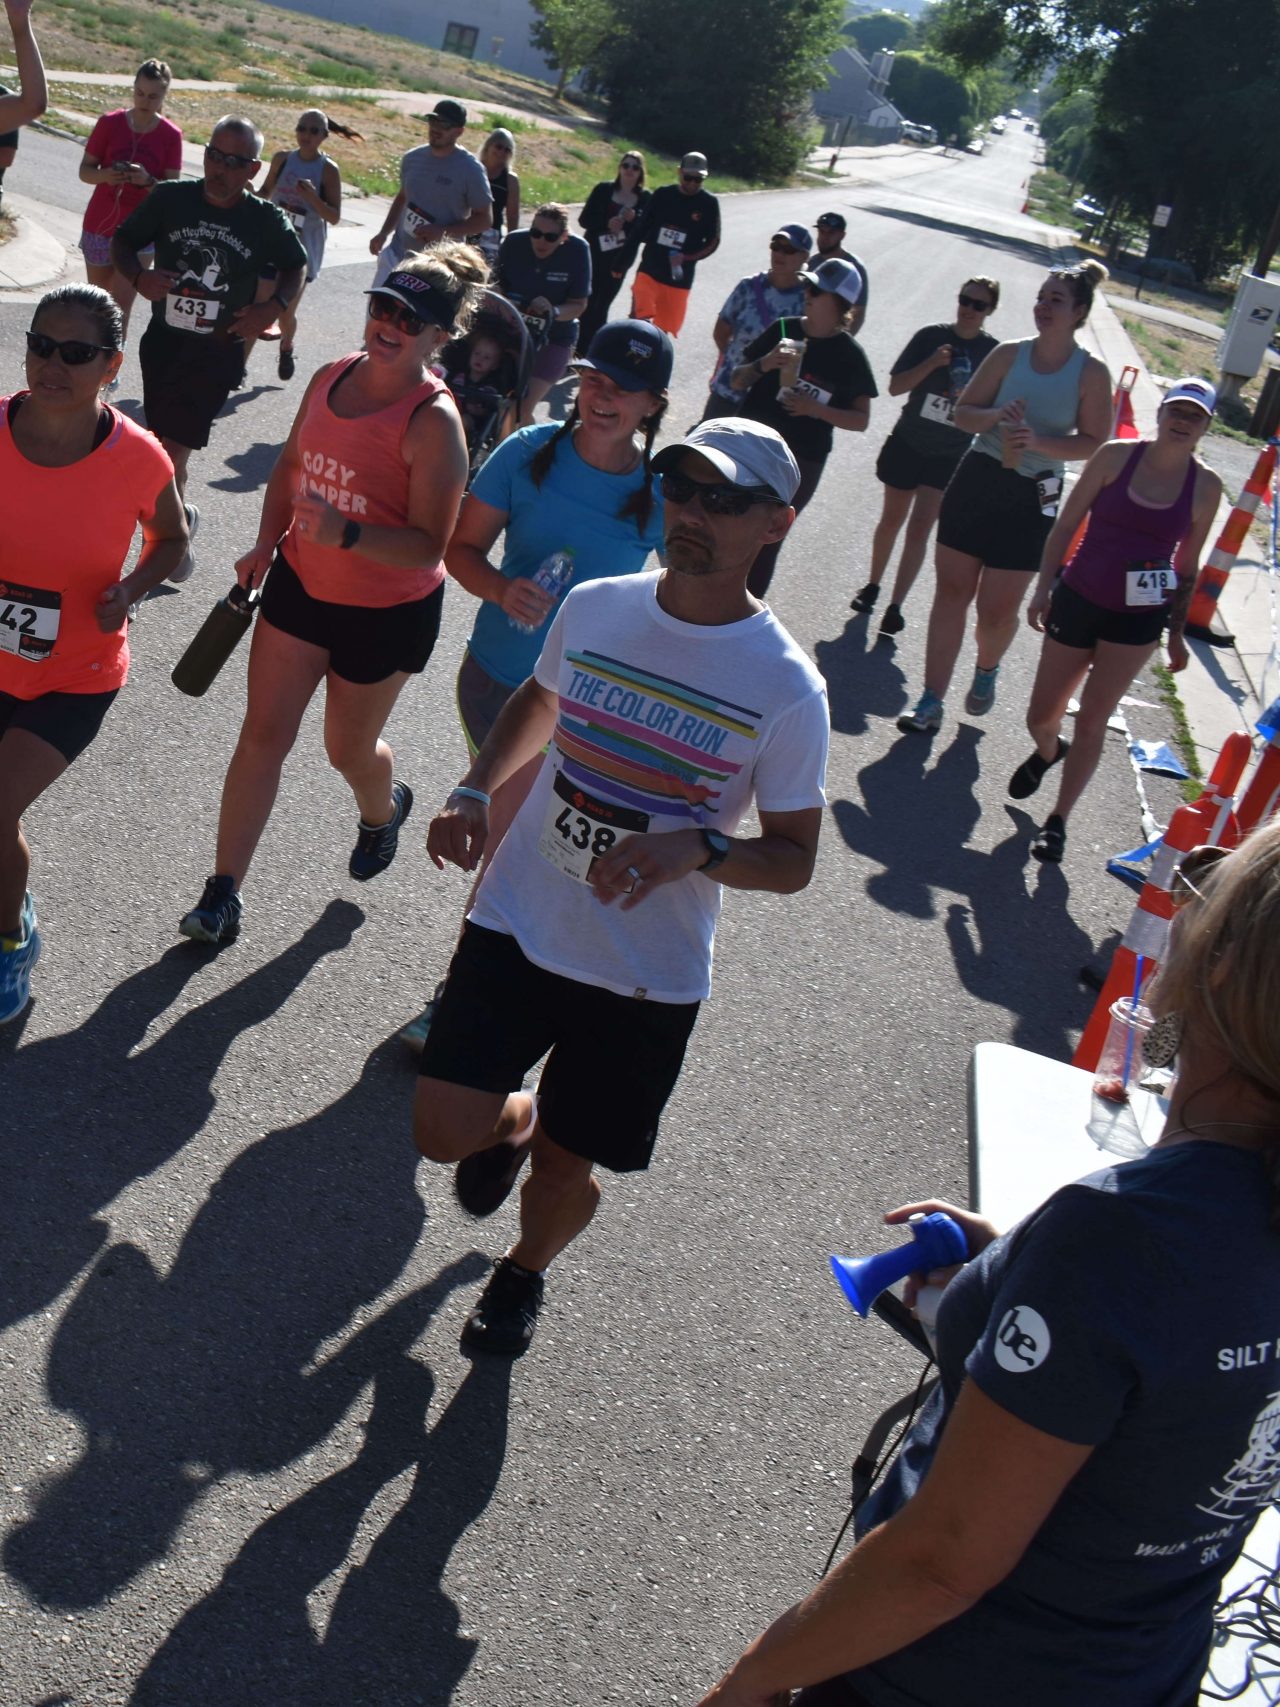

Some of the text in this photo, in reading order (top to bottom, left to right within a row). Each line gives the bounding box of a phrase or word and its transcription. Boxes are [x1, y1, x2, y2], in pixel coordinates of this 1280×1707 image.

[173, 298, 207, 318] 433
[303, 451, 356, 488] COZY
[299, 472, 368, 516] AMPER
[1136, 571, 1168, 589] 418
[567, 670, 607, 706] THE
[602, 686, 679, 735] COLOR
[555, 807, 616, 857] 438
[999, 1308, 1037, 1367] be
[1218, 1341, 1272, 1371] SILT
[1200, 1543, 1223, 1565] 5K
